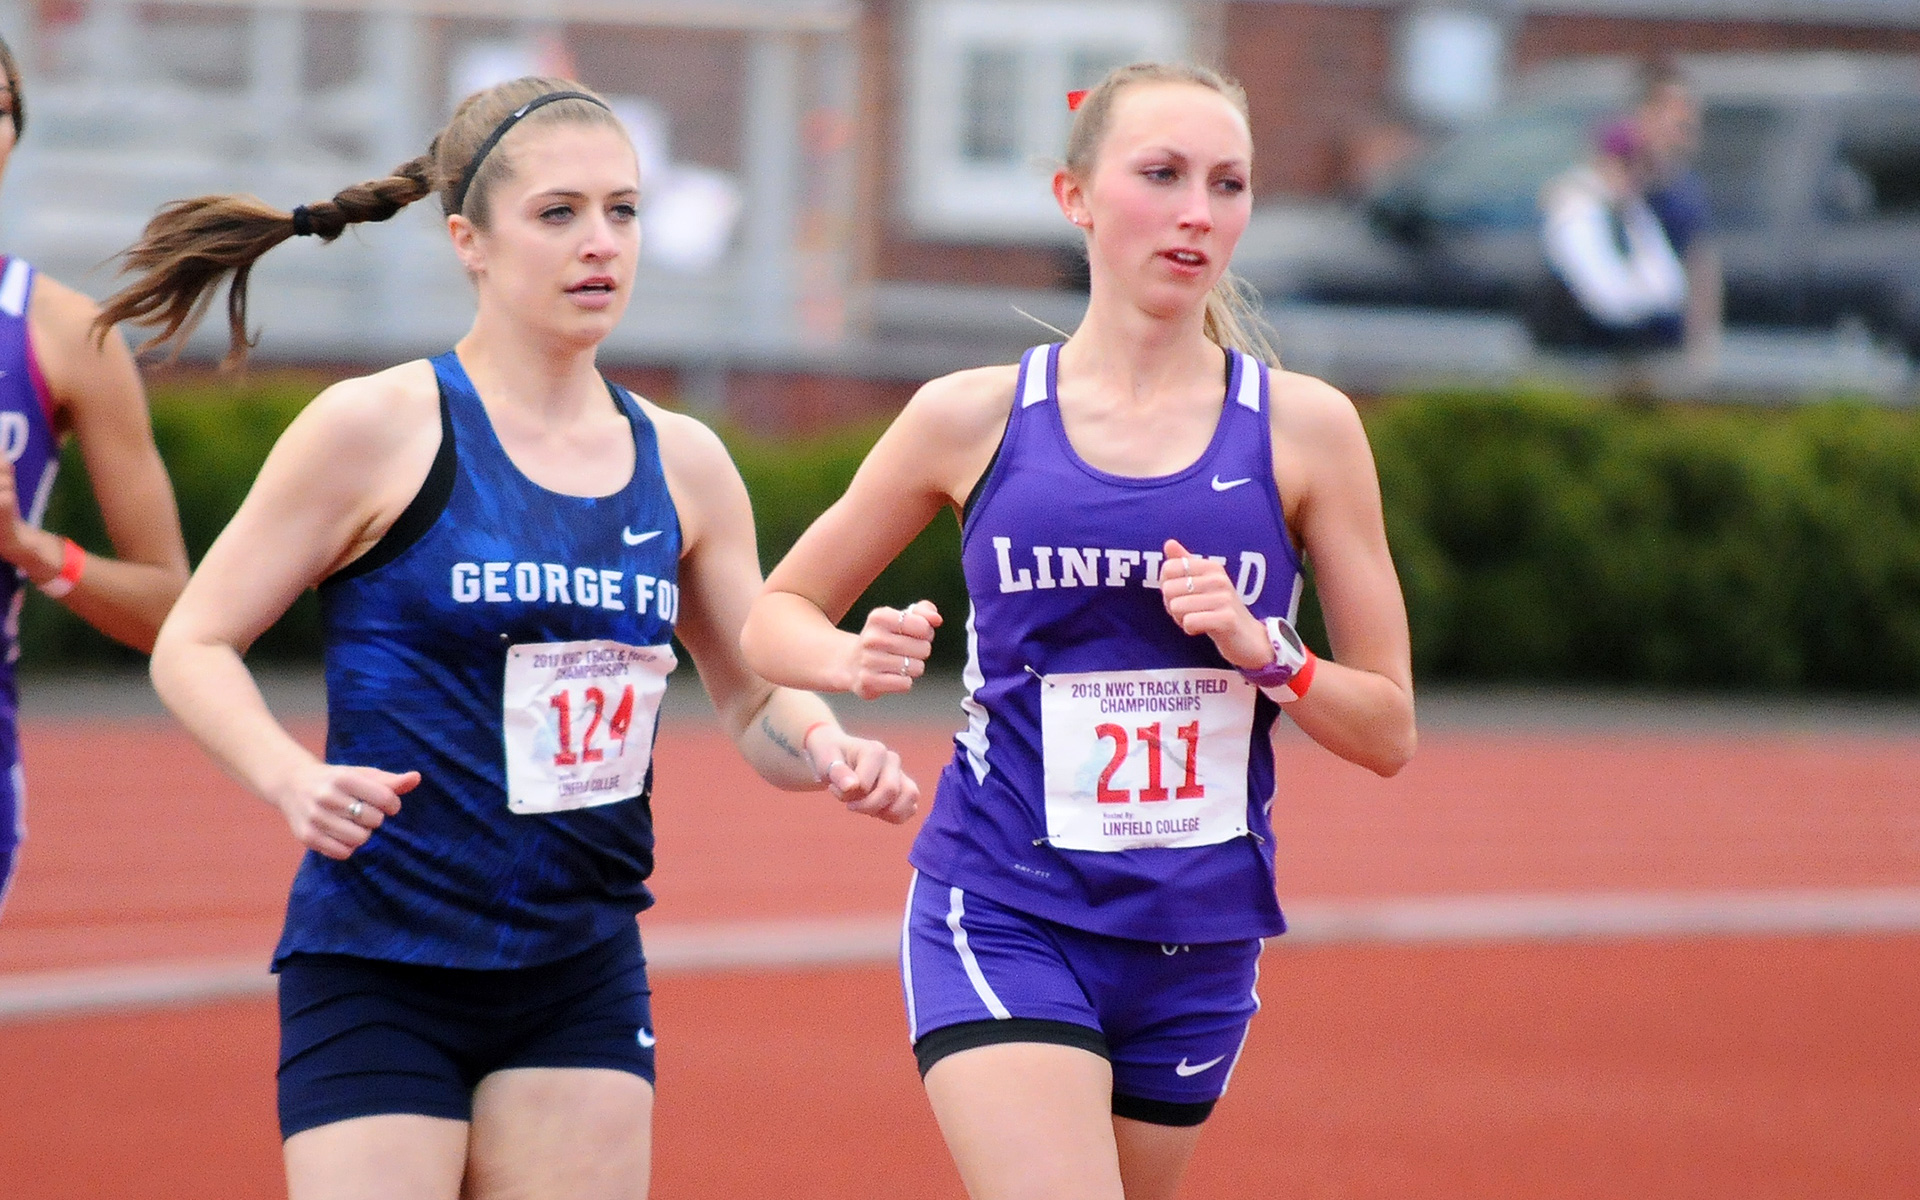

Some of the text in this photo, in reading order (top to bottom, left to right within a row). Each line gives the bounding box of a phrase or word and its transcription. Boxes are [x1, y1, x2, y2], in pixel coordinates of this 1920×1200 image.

[452, 562, 626, 611] GEORGE
[992, 536, 1267, 606] LINFID
[1071, 679, 1228, 698] 2018 NWC TRACK & FIELD
[1100, 696, 1201, 713] CHAMPIONSHIPS
[550, 684, 634, 766] 124
[1094, 720, 1205, 804] 211
[1103, 818, 1200, 836] LINFIELD COLLEGE
